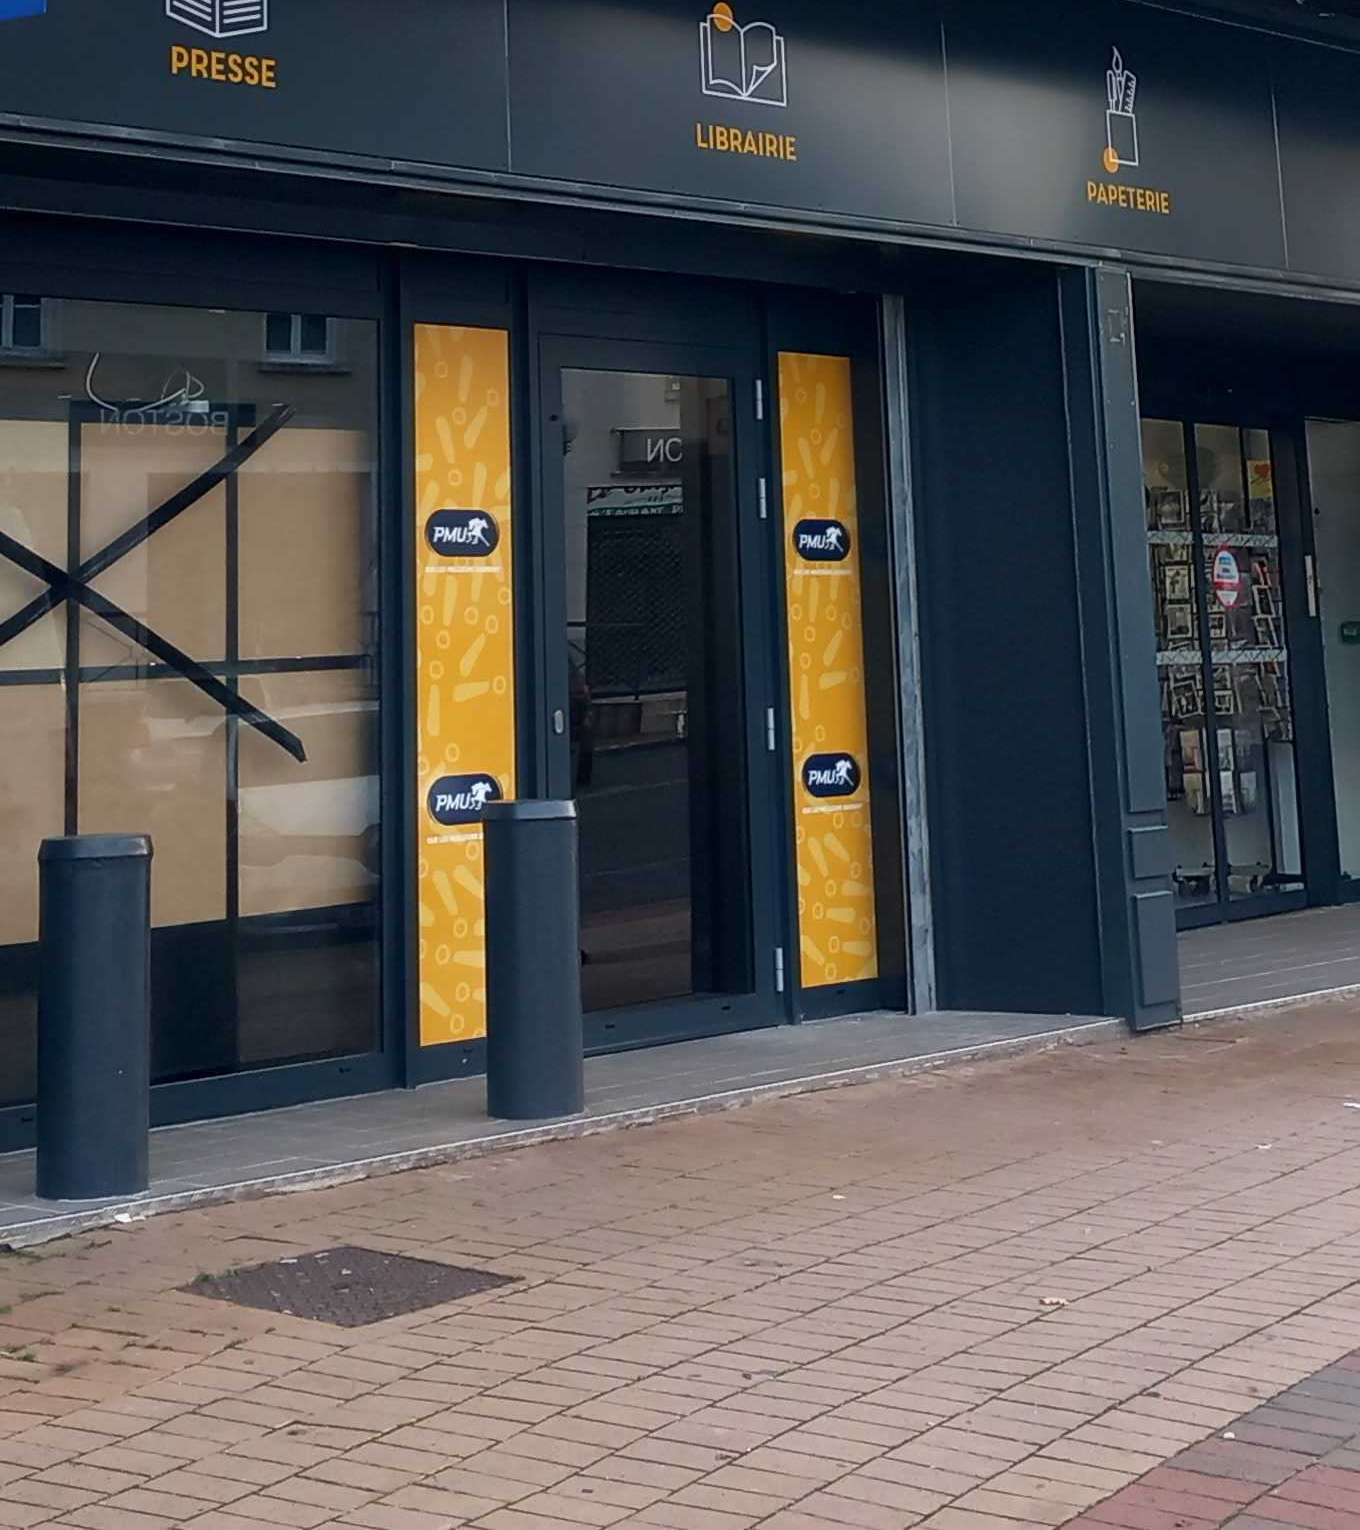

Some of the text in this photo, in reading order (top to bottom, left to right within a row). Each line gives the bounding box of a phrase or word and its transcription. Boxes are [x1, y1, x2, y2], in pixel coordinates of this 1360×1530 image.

[170, 45, 276, 88] PRESSE
[695, 122, 797, 161] LIBRAIRIE
[1086, 180, 1170, 214] PAPETERIE
[433, 526, 468, 543] PMU
[799, 533, 826, 549] PMU
[808, 769, 836, 786] PMU
[435, 792, 471, 812] PMU
